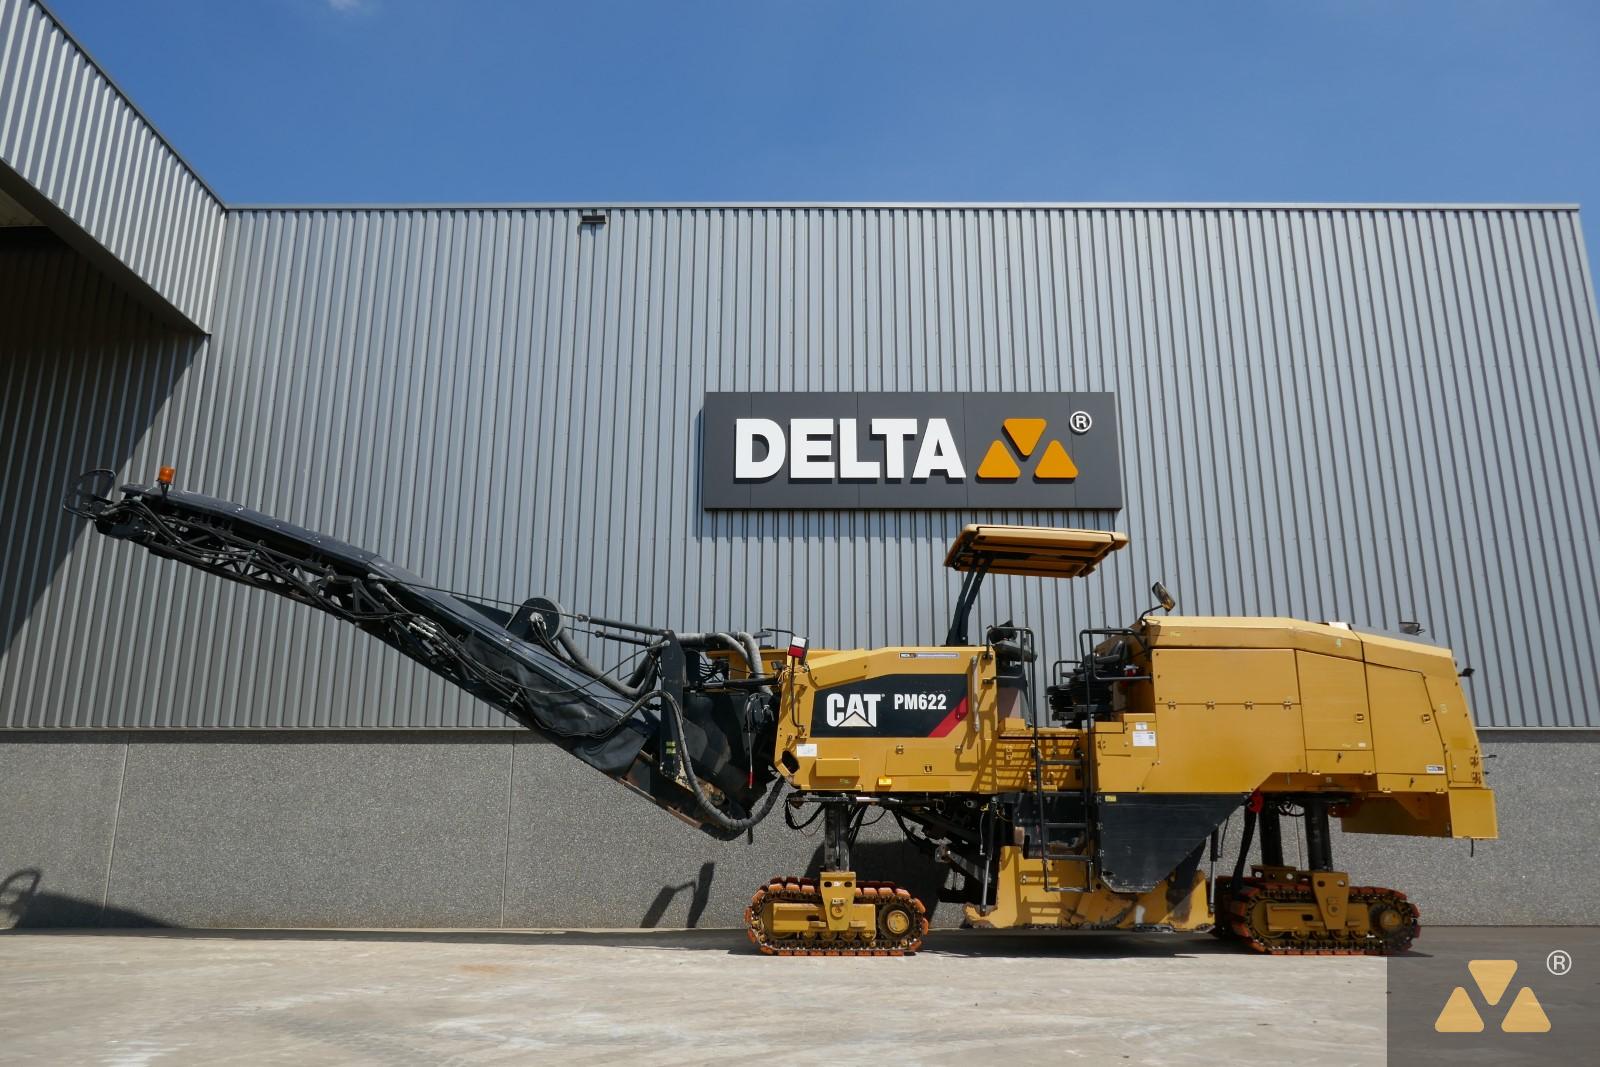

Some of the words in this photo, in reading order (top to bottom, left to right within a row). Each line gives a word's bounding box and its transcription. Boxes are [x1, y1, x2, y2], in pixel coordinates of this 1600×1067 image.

[735, 418, 967, 478] DELTA
[826, 693, 881, 727] CAT
[894, 693, 947, 710] PM622
